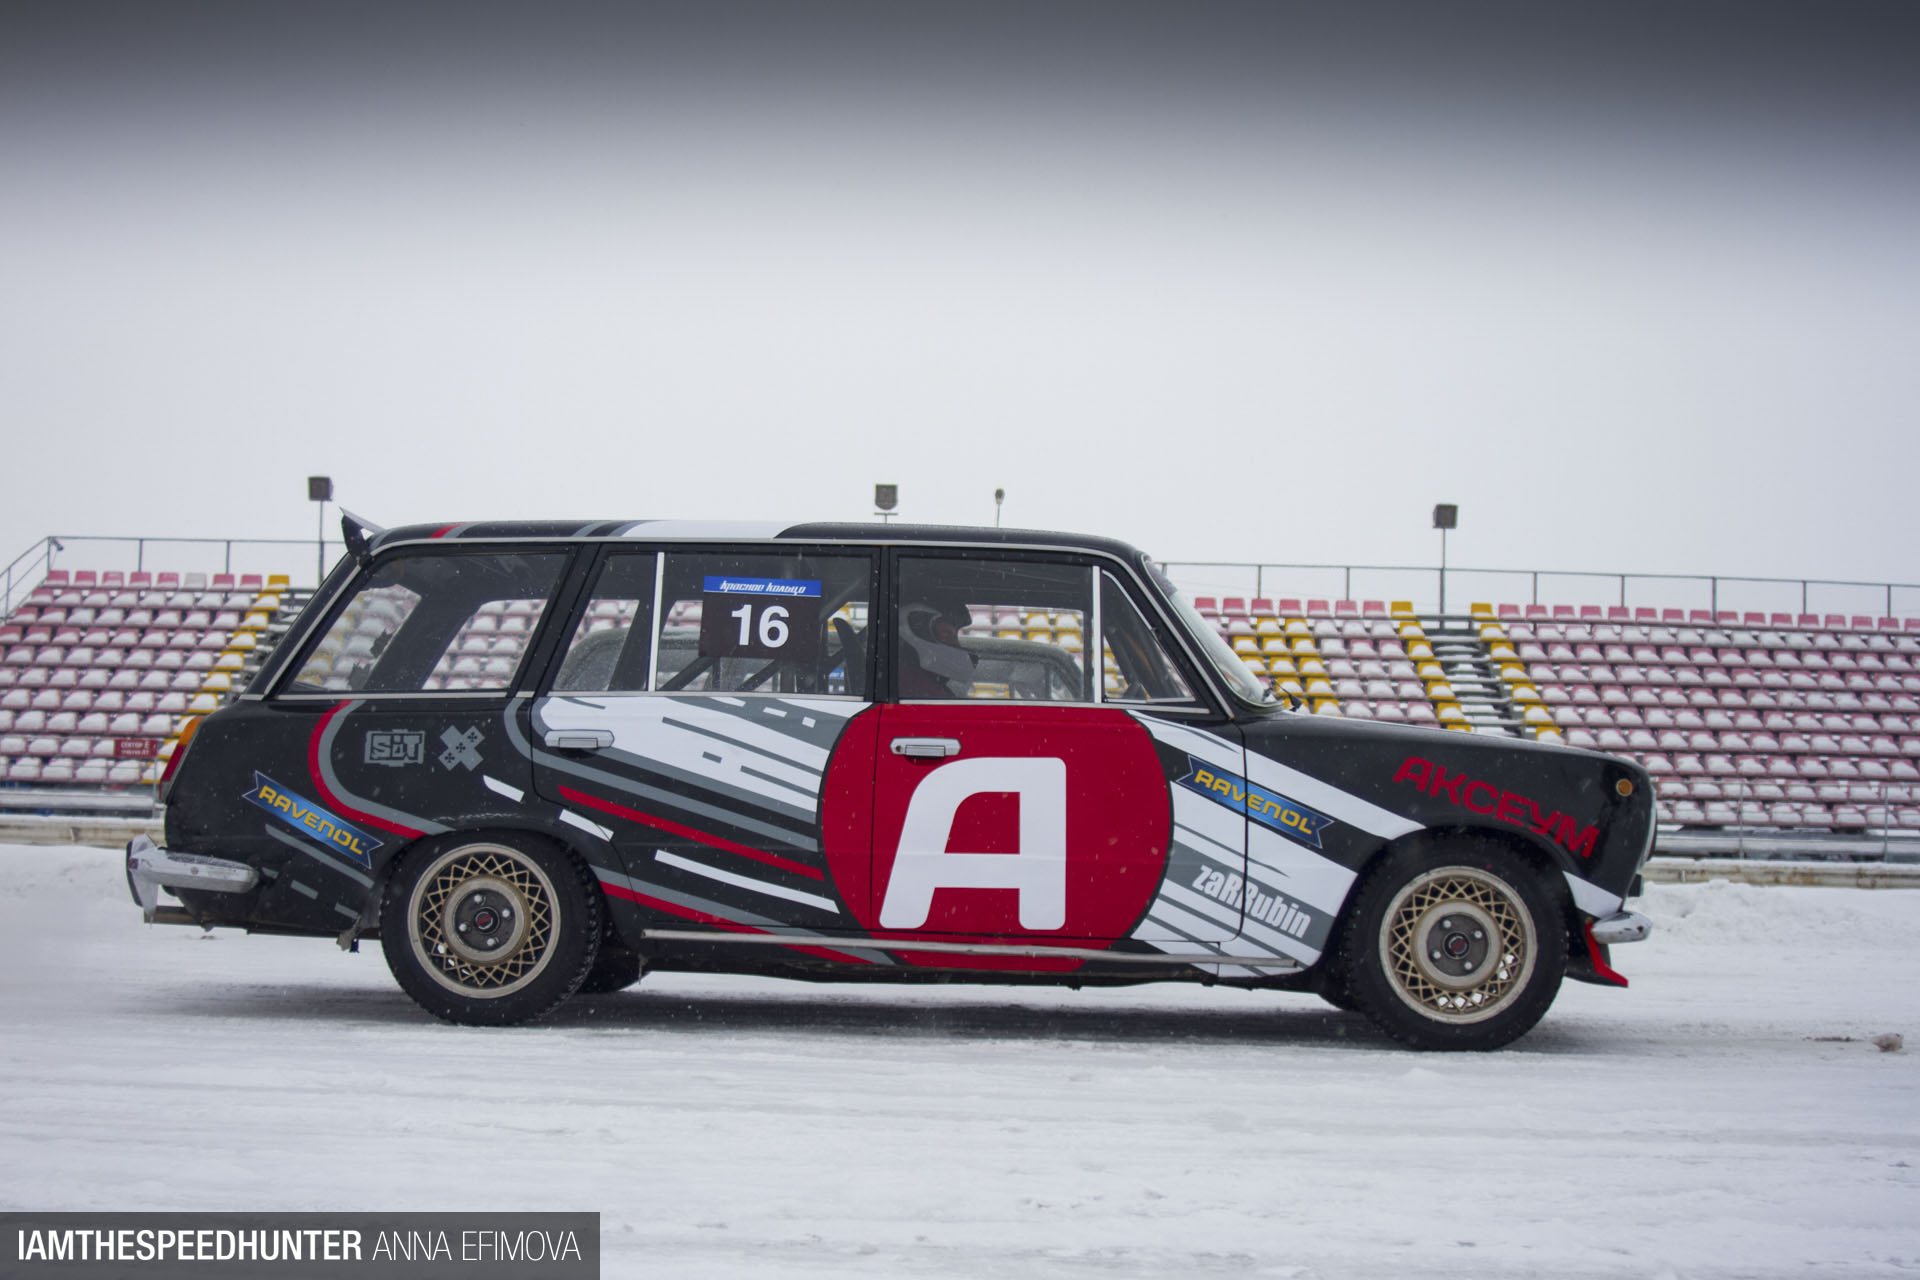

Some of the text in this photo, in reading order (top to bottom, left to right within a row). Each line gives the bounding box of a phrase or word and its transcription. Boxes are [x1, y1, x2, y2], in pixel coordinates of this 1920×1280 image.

[731, 604, 790, 648] 16
[259, 785, 362, 855] RAVENOL
[1195, 769, 1313, 835] RAVENOL
[879, 757, 1067, 930] A
